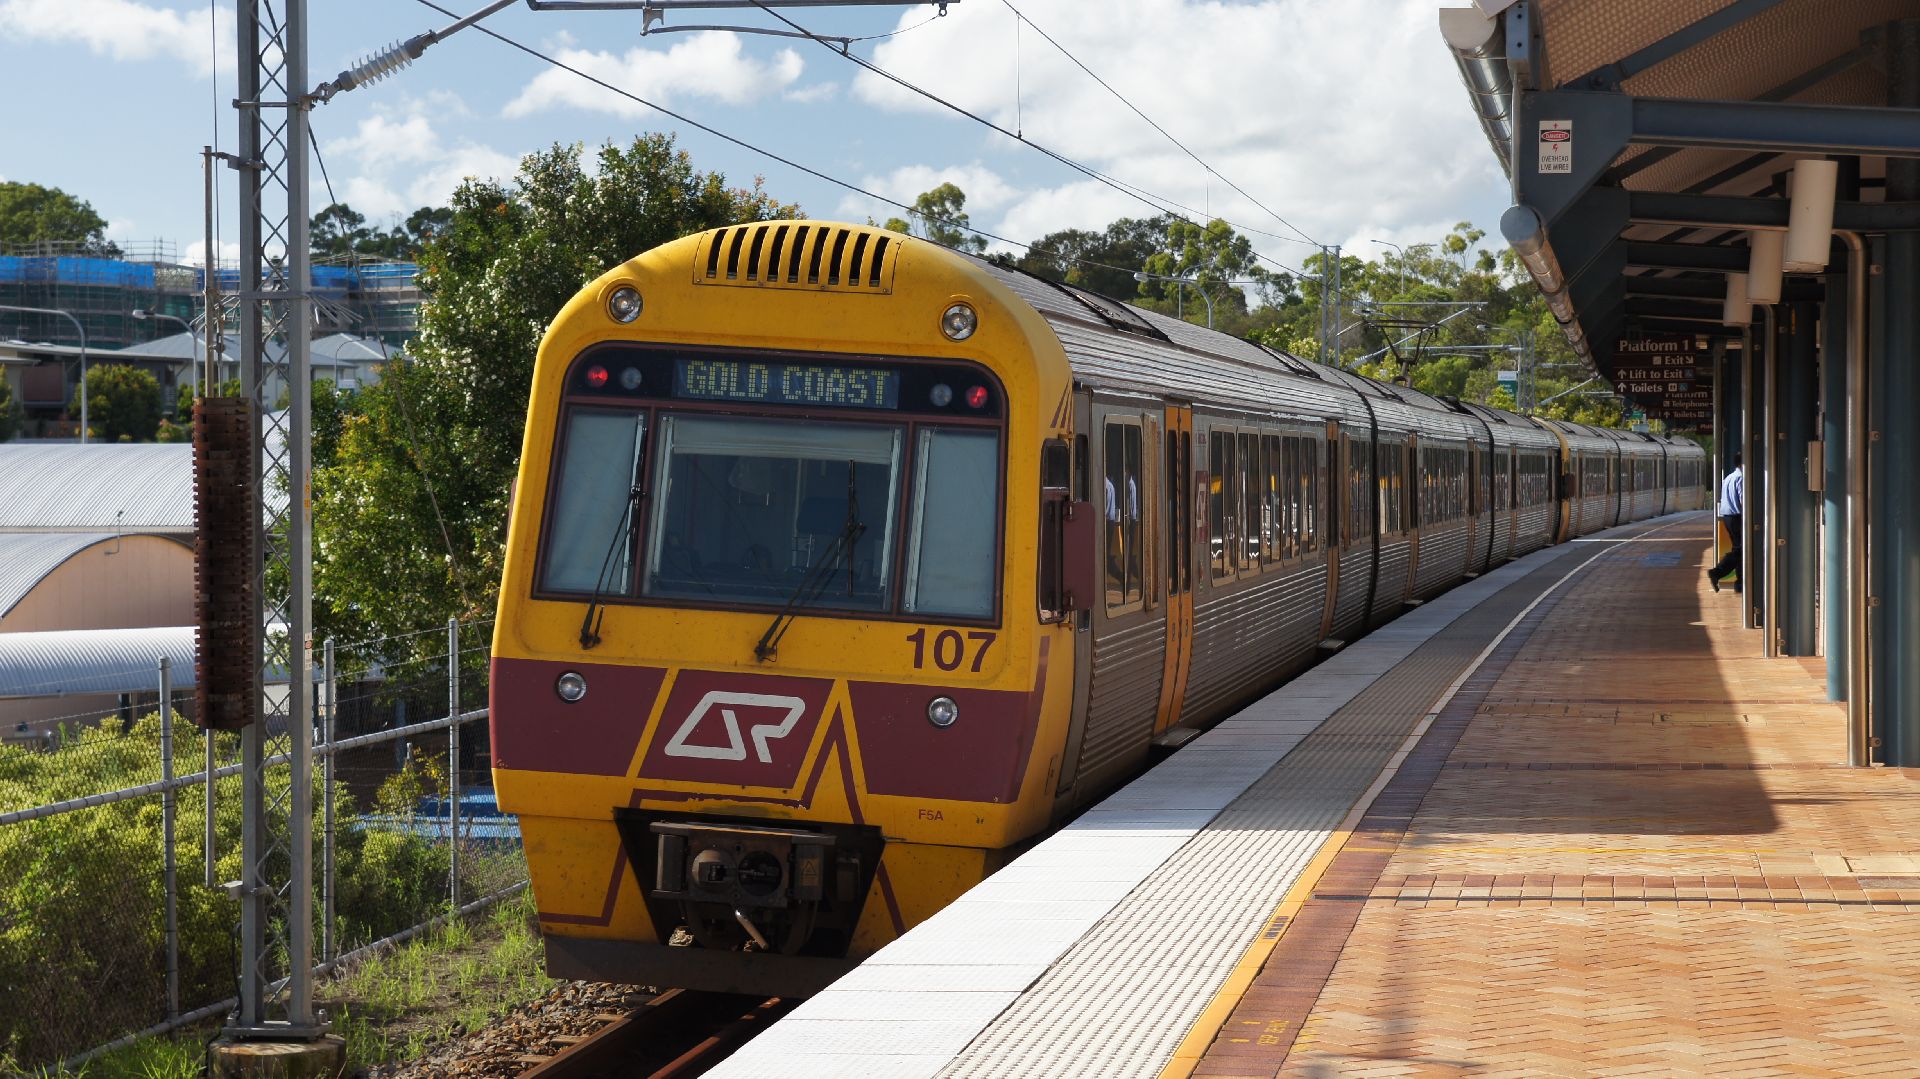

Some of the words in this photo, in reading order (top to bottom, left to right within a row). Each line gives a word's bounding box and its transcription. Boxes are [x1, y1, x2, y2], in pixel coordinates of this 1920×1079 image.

[1620, 339, 1678, 352] Platform
[1683, 340, 1689, 351] 1
[1665, 356, 1683, 365] Exit
[1629, 369, 1646, 379] Lift
[1650, 370, 1660, 379] to
[1664, 369, 1682, 379] Exit
[687, 360, 768, 398] GOLD
[783, 365, 891, 405] COAST
[1630, 383, 1662, 393] Toilets
[1673, 410, 1697, 418] Toilets
[906, 627, 998, 673] 107
[917, 808, 944, 822] F5A
